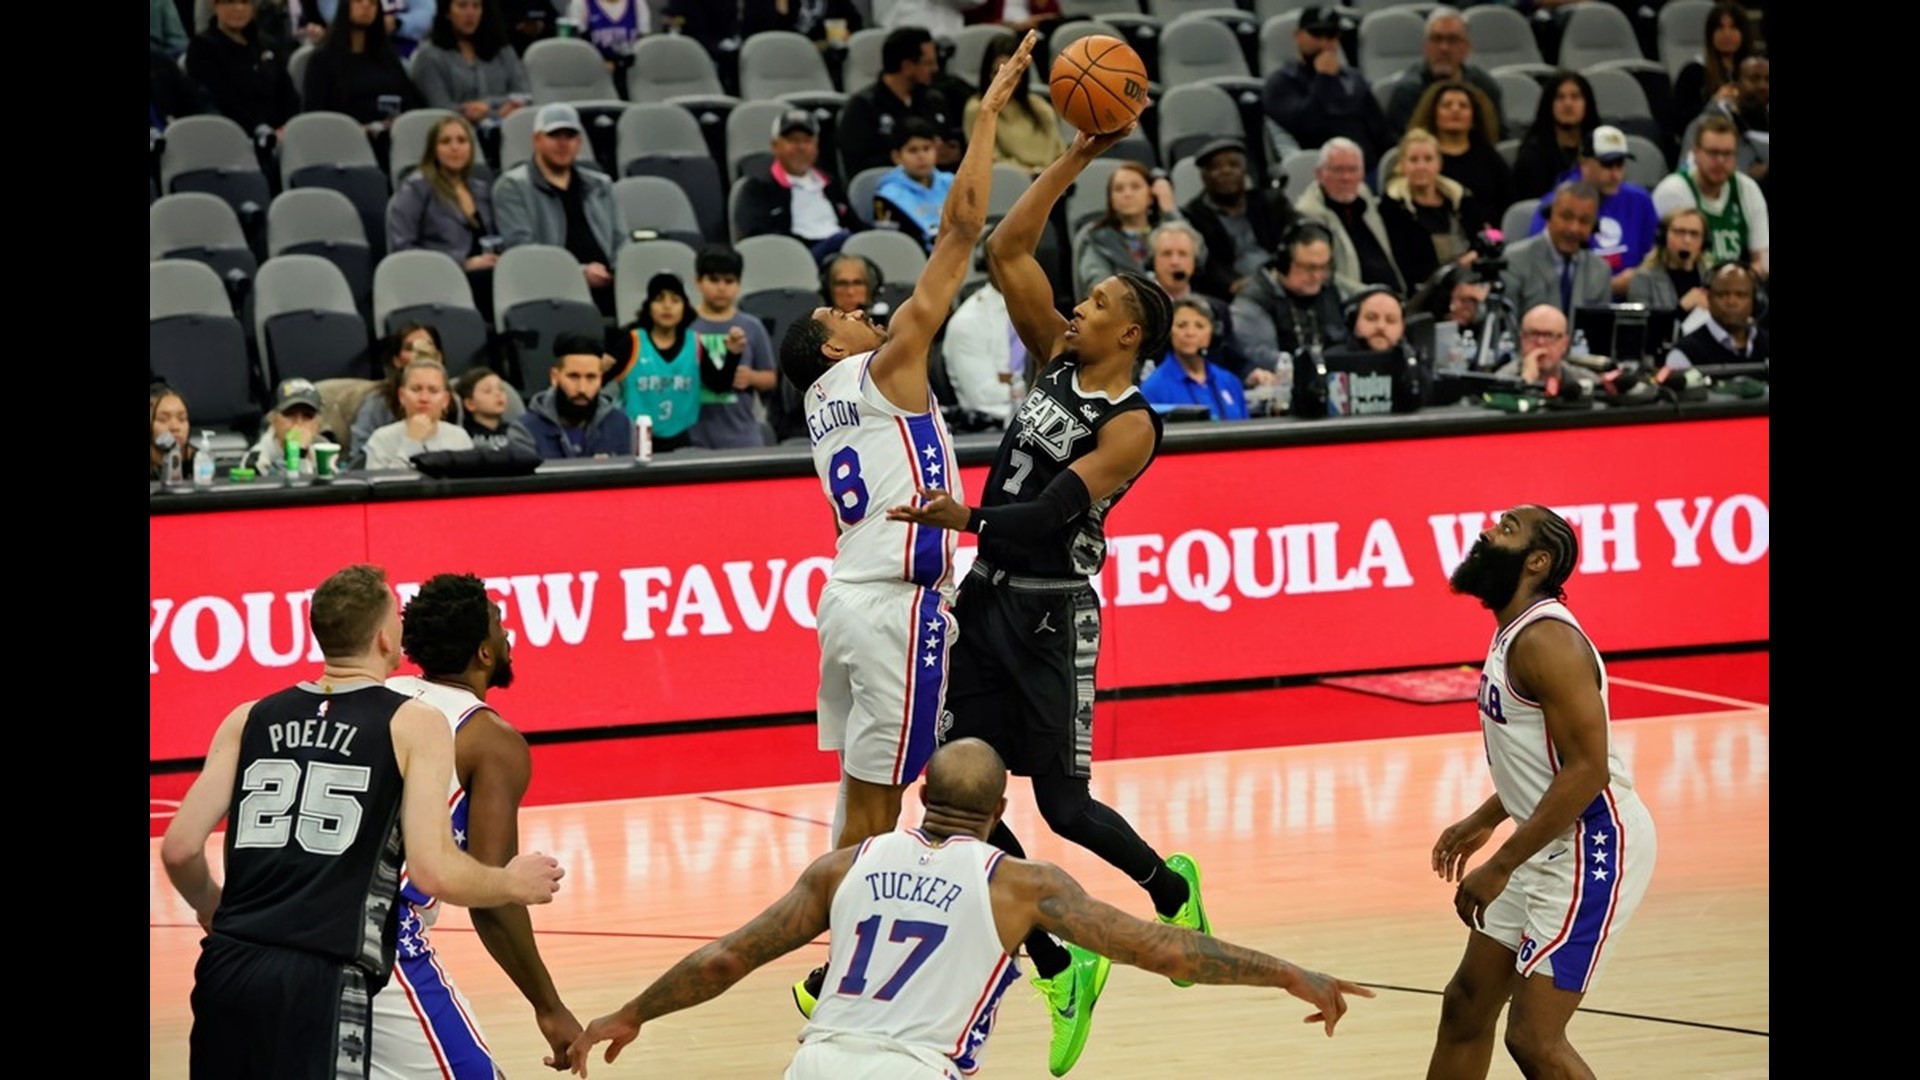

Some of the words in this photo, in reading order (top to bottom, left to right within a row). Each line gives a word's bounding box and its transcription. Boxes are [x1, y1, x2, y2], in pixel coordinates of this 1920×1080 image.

[658, 400, 673, 420] 3
[808, 400, 860, 446] ELTON
[828, 445, 870, 526] 8
[1002, 448, 1034, 495] 7
[268, 719, 358, 757] POELTL
[234, 759, 372, 856] 25
[865, 871, 963, 913] TUCKER
[837, 914, 949, 1002] 17
